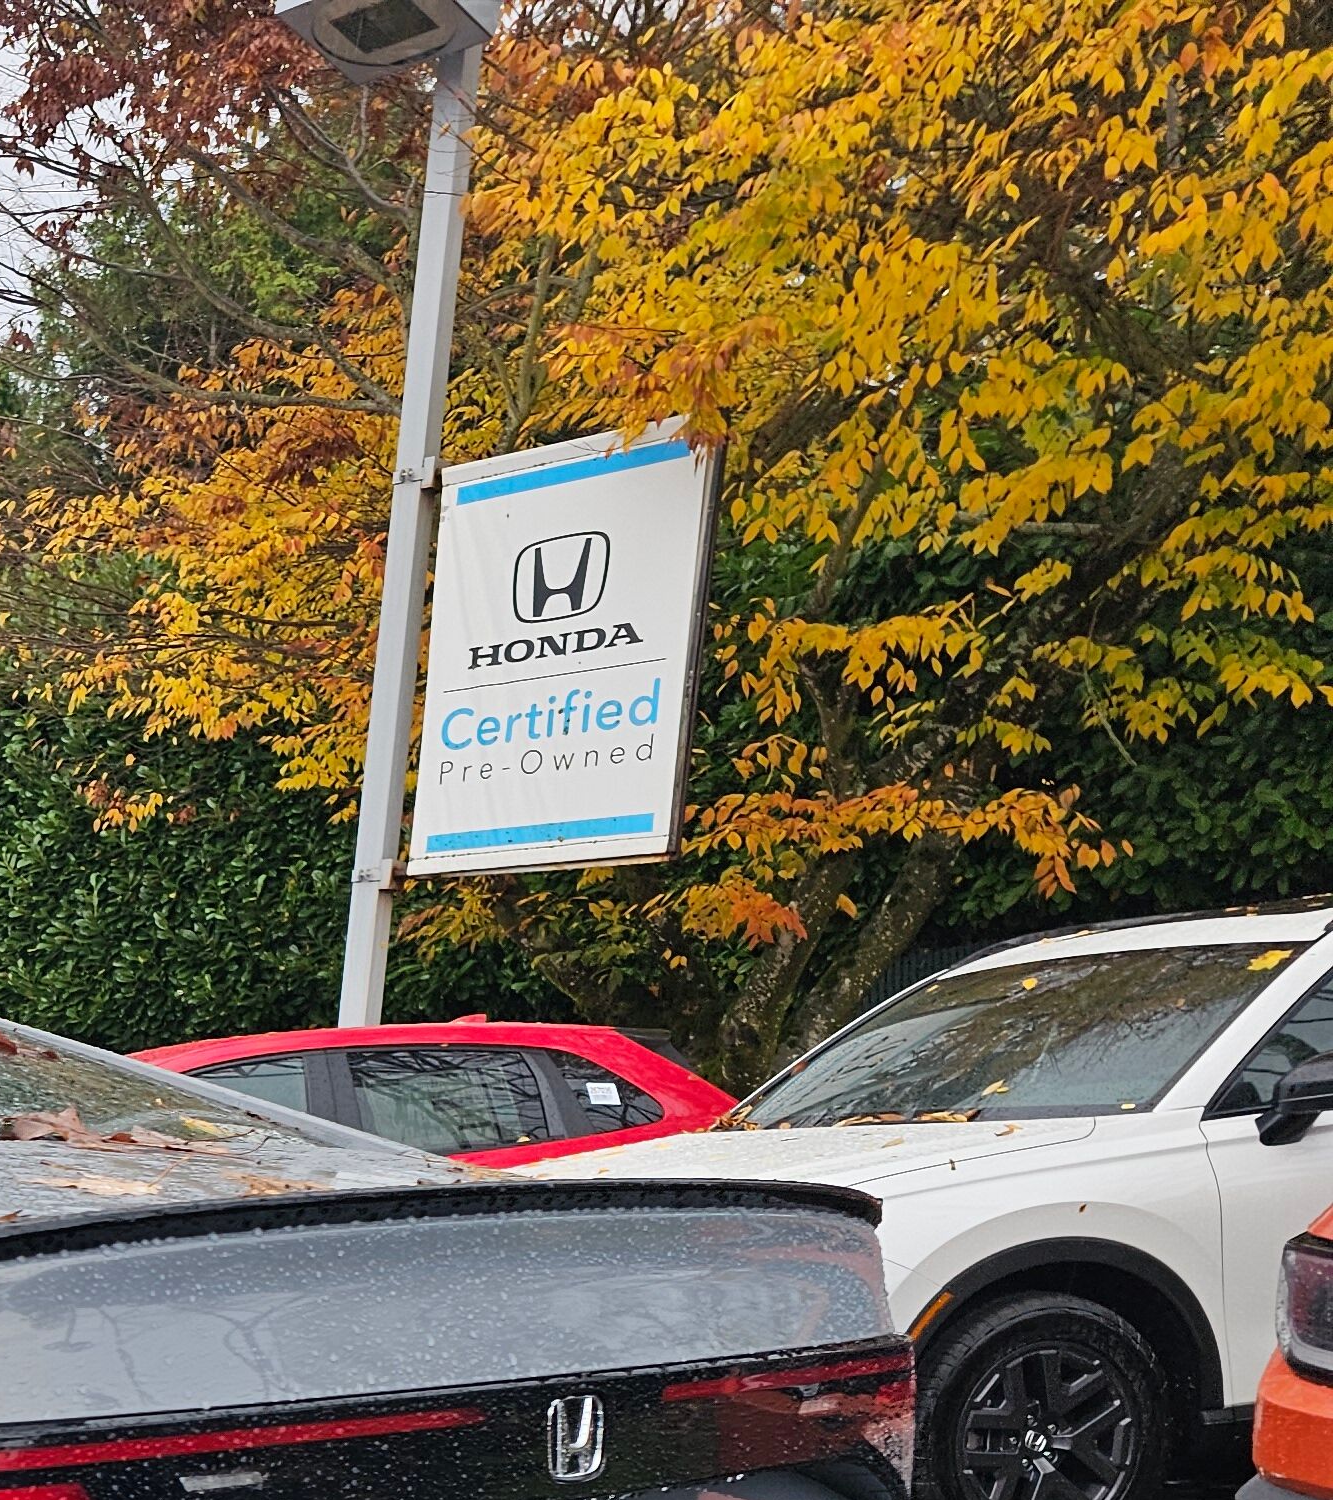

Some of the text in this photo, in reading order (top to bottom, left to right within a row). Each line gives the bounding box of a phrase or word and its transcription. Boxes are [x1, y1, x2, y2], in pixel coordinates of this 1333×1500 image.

[467, 622, 644, 670] HONDA
[440, 677, 662, 751] Certified
[438, 734, 655, 785] Pre-Owned
